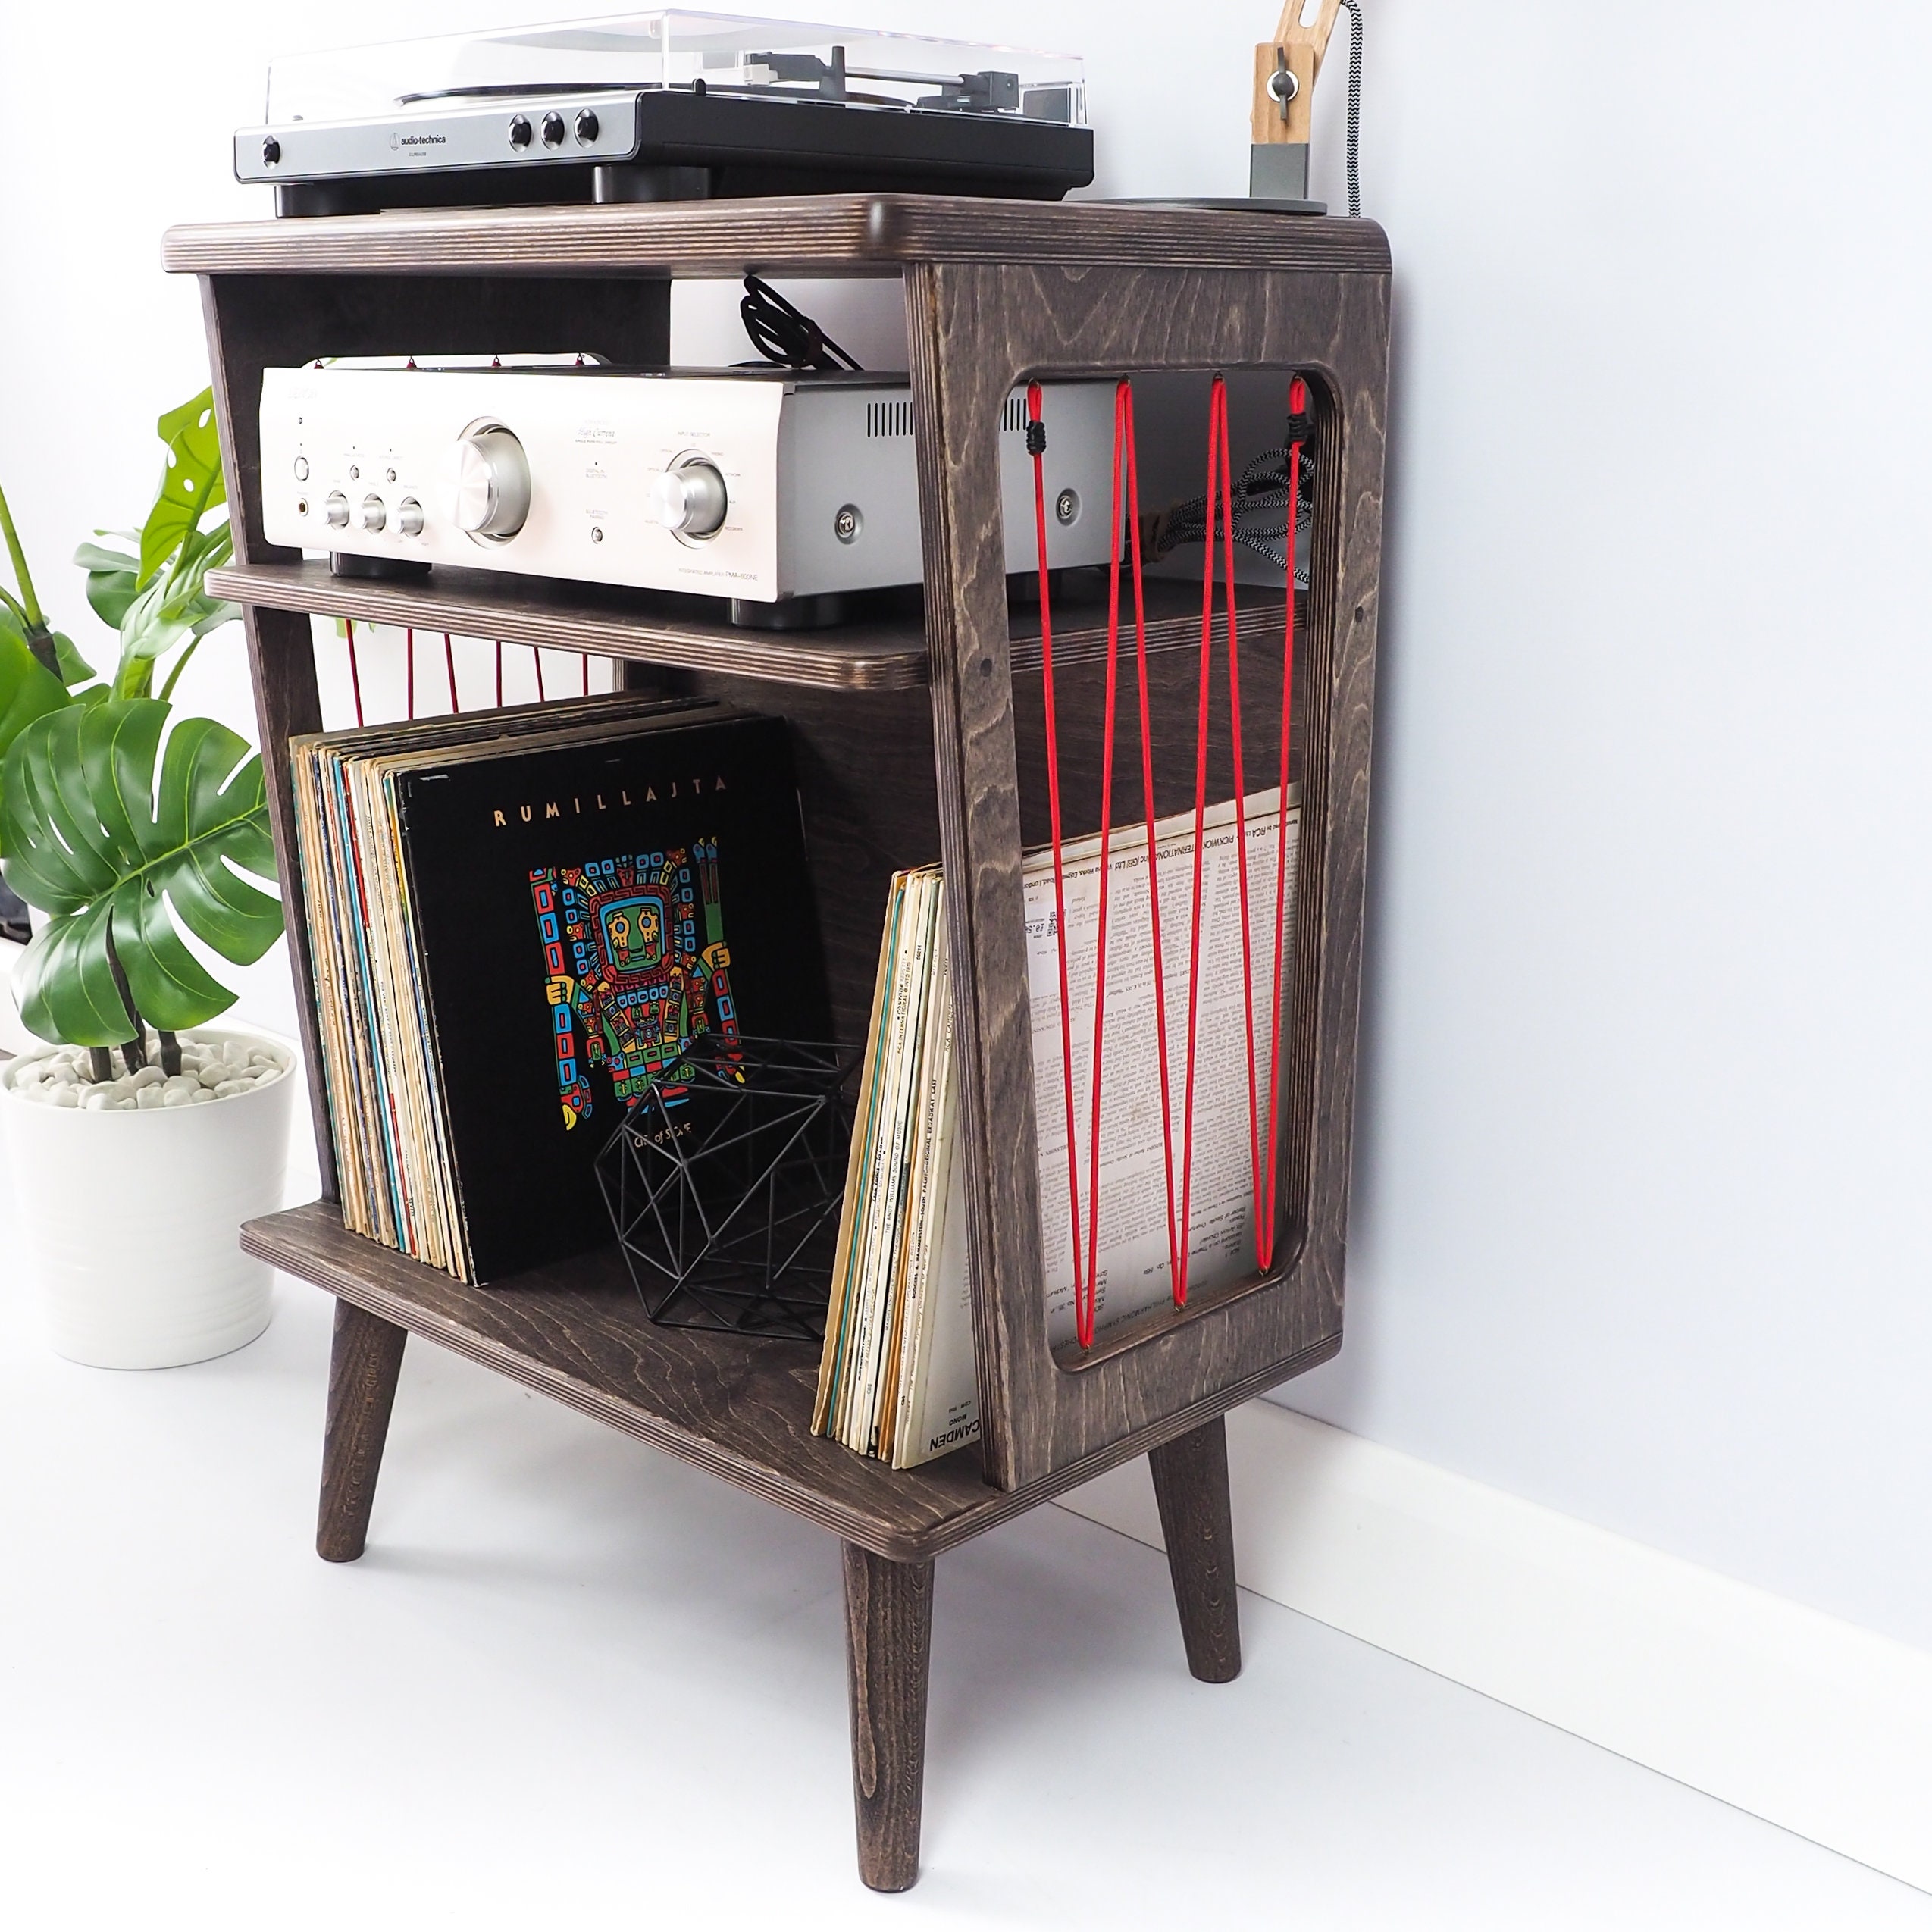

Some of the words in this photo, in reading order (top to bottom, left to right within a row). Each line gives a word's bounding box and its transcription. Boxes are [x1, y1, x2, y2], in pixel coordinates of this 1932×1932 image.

[401, 134, 446, 145] audio-technica
[493, 775, 726, 827] RUMILLAJTA
[1251, 825, 1267, 838] RCA
[654, 1131, 663, 1144] of
[888, 1175, 897, 1202] WILLIAMS
[949, 1414, 967, 1426] MONO
[929, 1419, 981, 1451] CAMDEN
